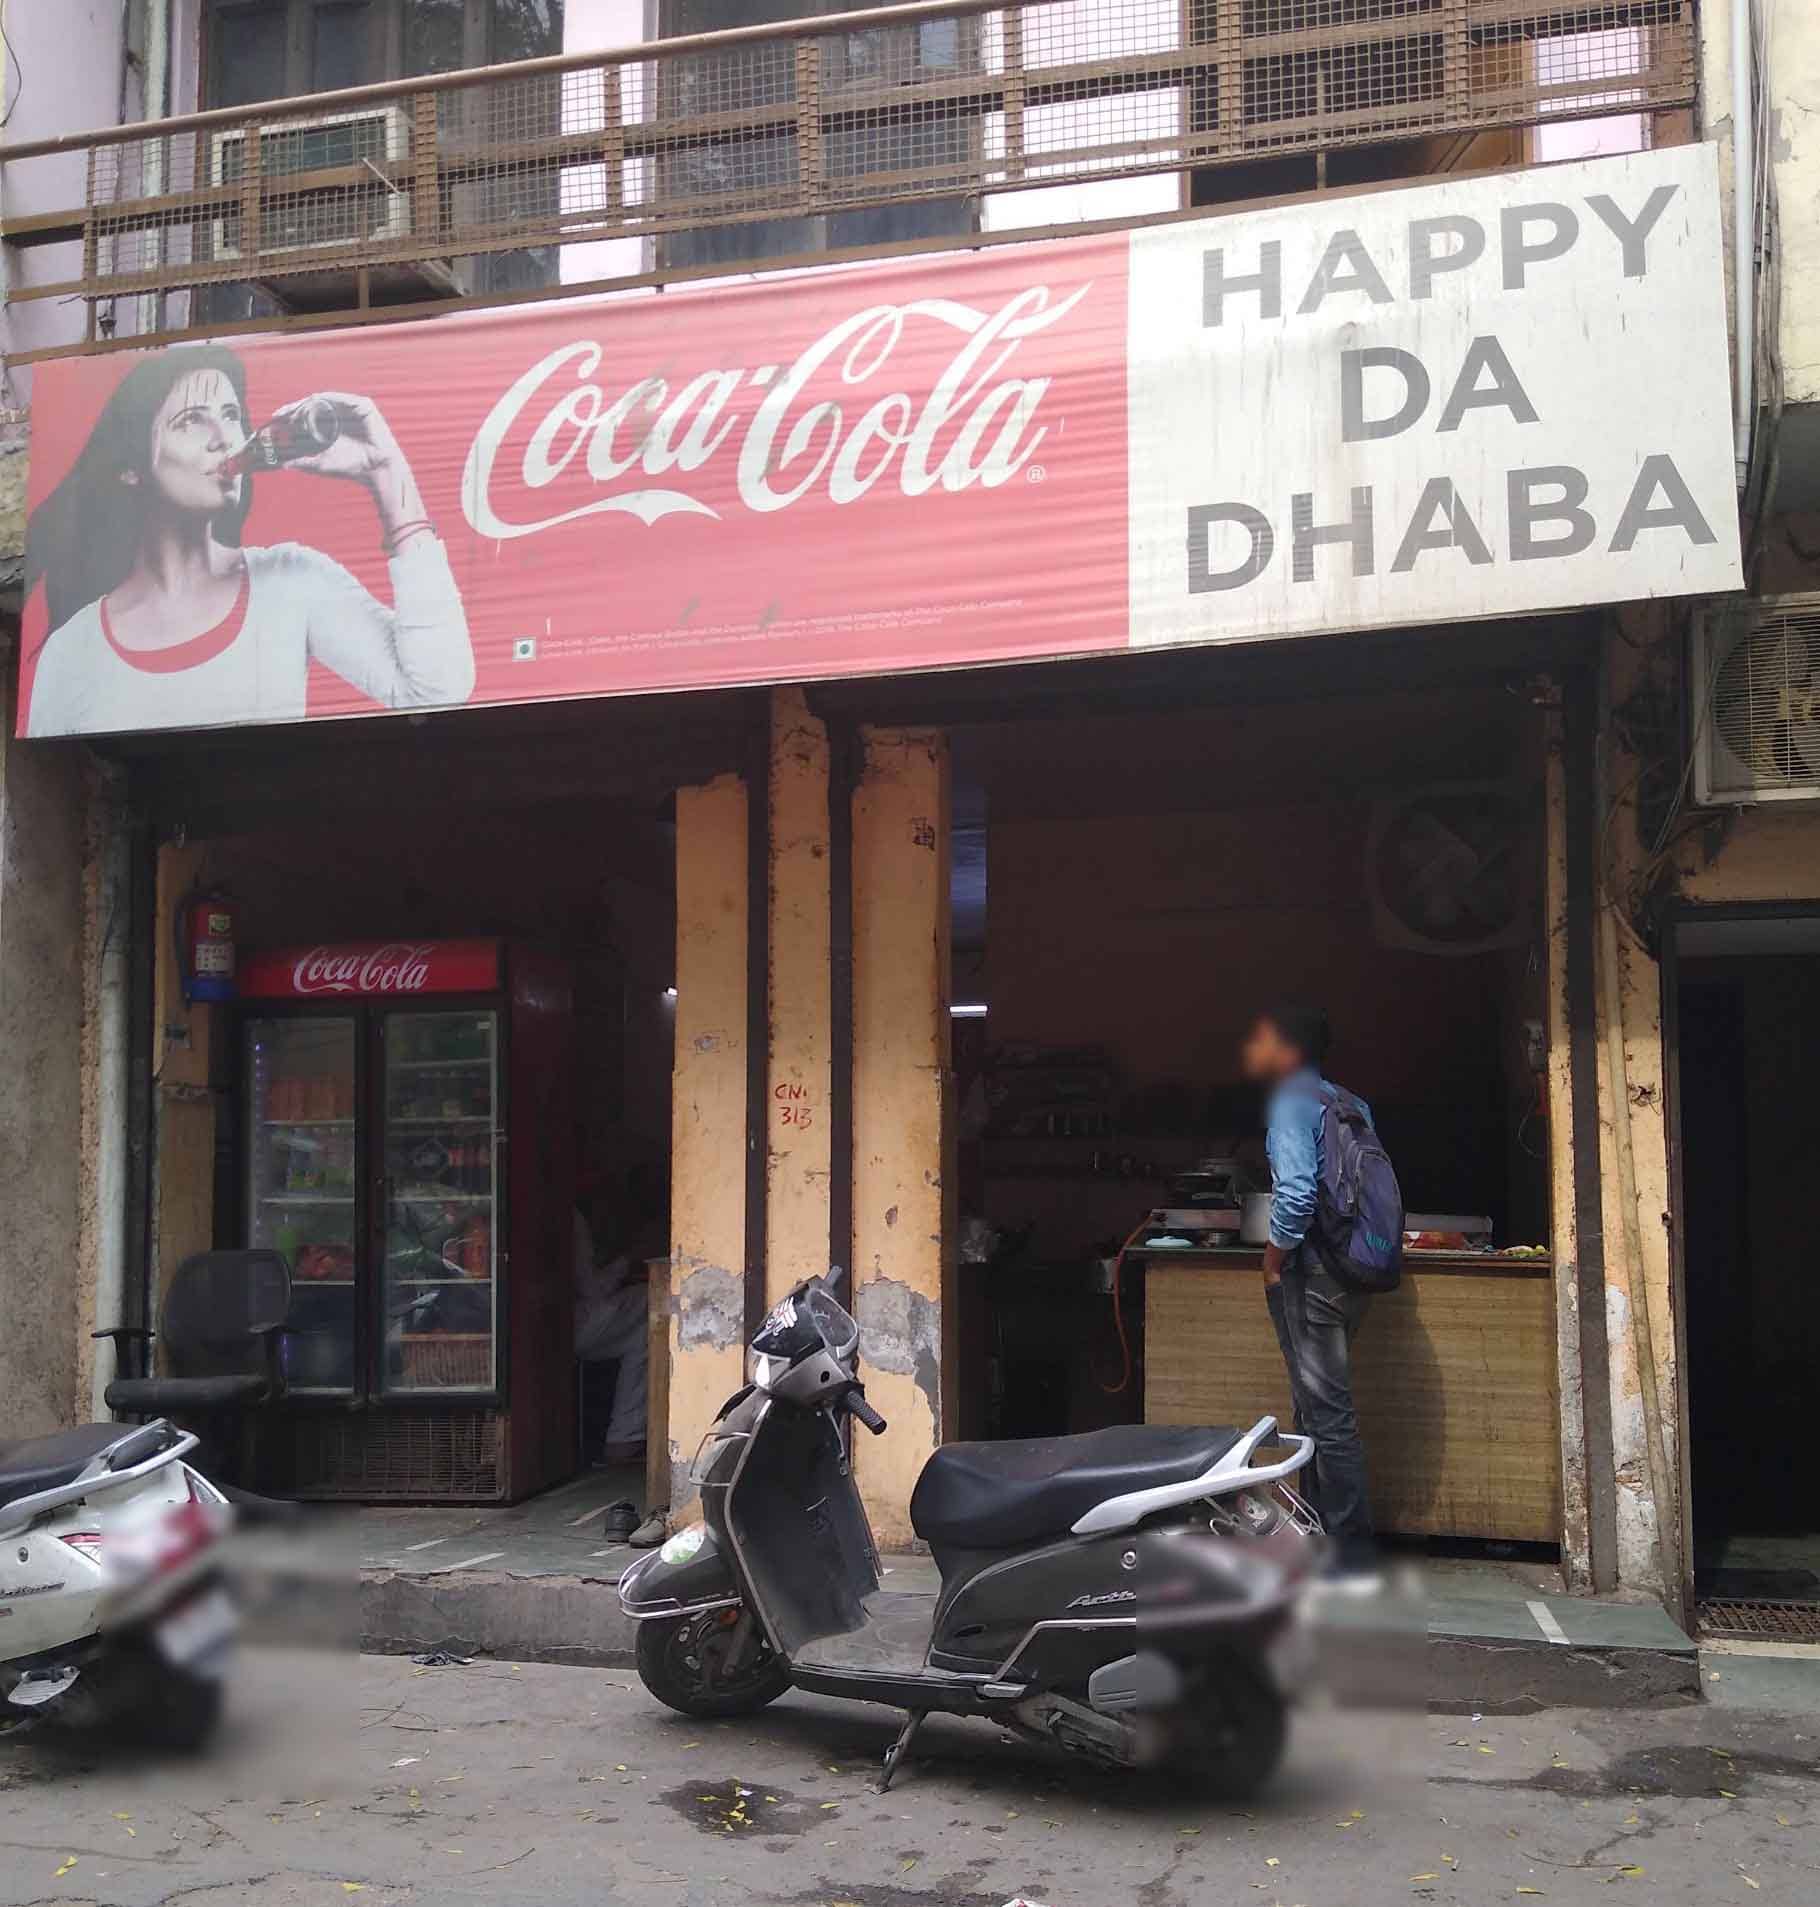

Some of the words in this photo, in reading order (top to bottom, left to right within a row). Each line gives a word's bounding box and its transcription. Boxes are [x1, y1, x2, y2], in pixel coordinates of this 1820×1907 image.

[1201, 183, 1680, 328] HAPPY
[461, 280, 1094, 540] Coca-Cola
[1340, 334, 1539, 443] DA
[1186, 453, 1718, 594] DHABA
[293, 943, 438, 993] Coca-Cola
[779, 1105, 812, 1130] 313
